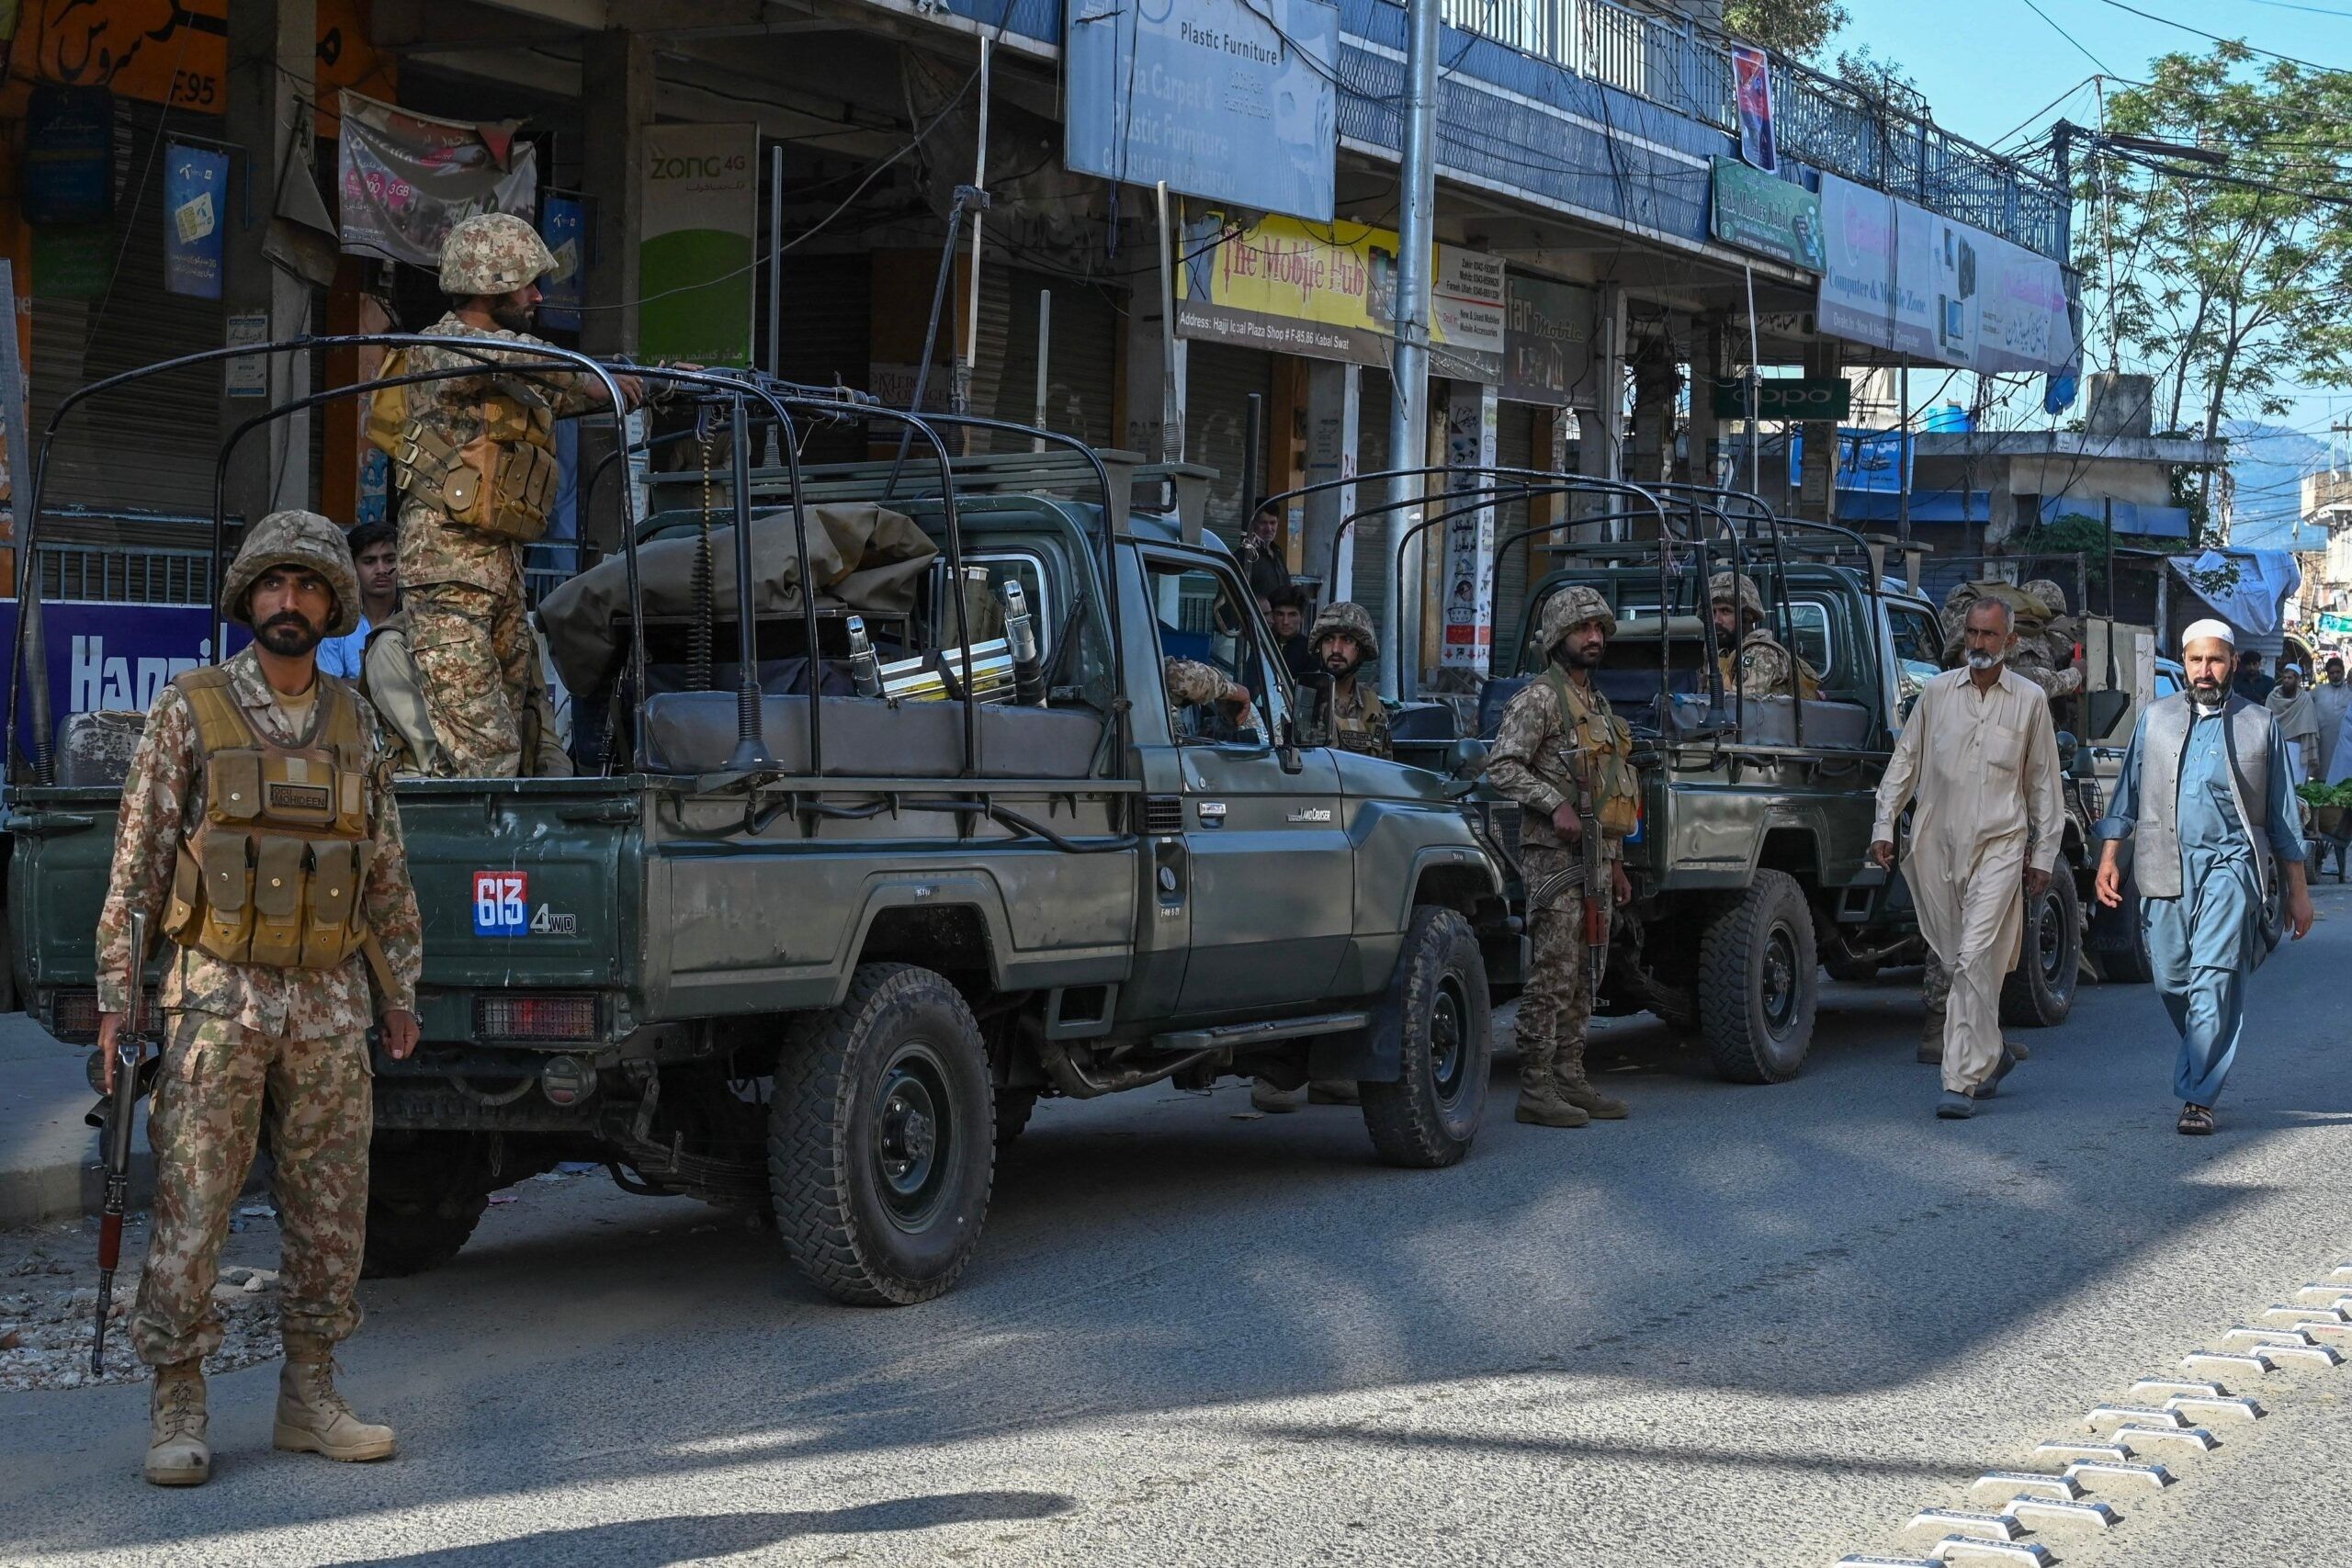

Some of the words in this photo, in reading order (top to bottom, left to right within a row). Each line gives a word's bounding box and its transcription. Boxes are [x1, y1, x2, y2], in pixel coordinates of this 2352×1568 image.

[1182, 22, 1219, 50] Plastic
[1224, 34, 1277, 65] Furniture
[1152, 62, 1201, 113] Carpet
[1164, 113, 1228, 160] Furniture
[724, 155, 745, 170] 4G
[396, 186, 410, 197] GB
[1224, 228, 1257, 294] The
[1261, 236, 1324, 303] Mobile
[1329, 250, 1364, 297] Hub
[1828, 265, 1869, 299] Computer
[1870, 280, 1877, 299] &
[1907, 289, 1926, 314] Zone
[1180, 311, 1212, 329] Address:
[1213, 317, 1229, 334] Hajji
[1247, 322, 1265, 337] Plaza
[1267, 325, 1283, 343] Shop
[1285, 328, 1290, 341] #
[1315, 333, 1333, 347] Kabal
[1333, 335, 1349, 350] Swat
[1533, 310, 1586, 344] Mobile
[1895, 329, 1919, 346] Computer
[275, 795, 324, 807] MOHIDEEN
[478, 878, 524, 927] 613
[530, 903, 577, 934] 4WD
